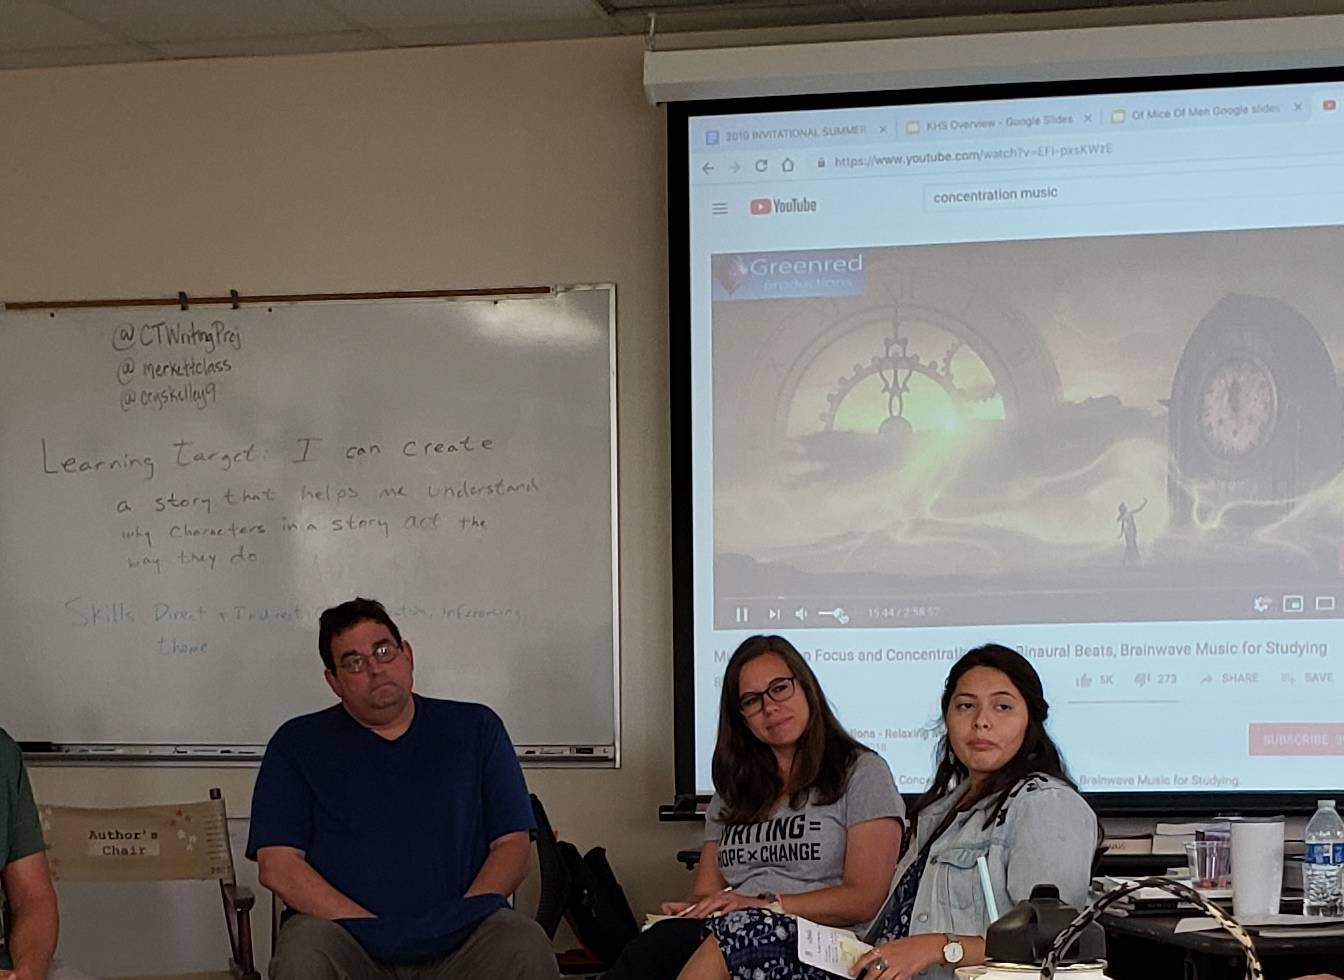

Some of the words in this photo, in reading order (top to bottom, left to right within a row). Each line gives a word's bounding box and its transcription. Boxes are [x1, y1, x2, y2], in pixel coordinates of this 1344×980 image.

[950, 118, 996, 131] Overview
[1006, 115, 1041, 129] Google
[773, 198, 817, 214] YouTube
[933, 188, 1018, 205] concentration
[1020, 185, 1058, 200] music
[750, 254, 863, 277] Greenred
[41, 437, 155, 480] Learning
[291, 437, 323, 464] I
[345, 442, 382, 460] can
[116, 499, 133, 513] a
[154, 491, 212, 515] story
[223, 488, 275, 505] that
[300, 482, 360, 503] helps
[378, 485, 408, 498] me
[427, 477, 540, 500] understand
[331, 513, 390, 538] story
[457, 514, 490, 530] the
[127, 555, 161, 576] way
[177, 550, 217, 571] they
[229, 543, 259, 565] do
[816, 648, 855, 661] Focus
[857, 647, 883, 661] and
[886, 646, 964, 662] Concentrat
[1075, 643, 1117, 660] Beats,
[1120, 642, 1192, 658] Brainwave
[1195, 642, 1238, 657] Music
[1241, 641, 1263, 655] for
[1265, 640, 1328, 659] Studying
[1221, 672, 1259, 684] SHARE
[1304, 672, 1334, 684] SAVE
[1079, 775, 1135, 786] Brainwave
[1137, 775, 1170, 787] Music
[87, 828, 159, 841] Author's
[719, 813, 806, 847] WRITING
[102, 845, 147, 857] Chair
[759, 842, 822, 864] CHANGE
